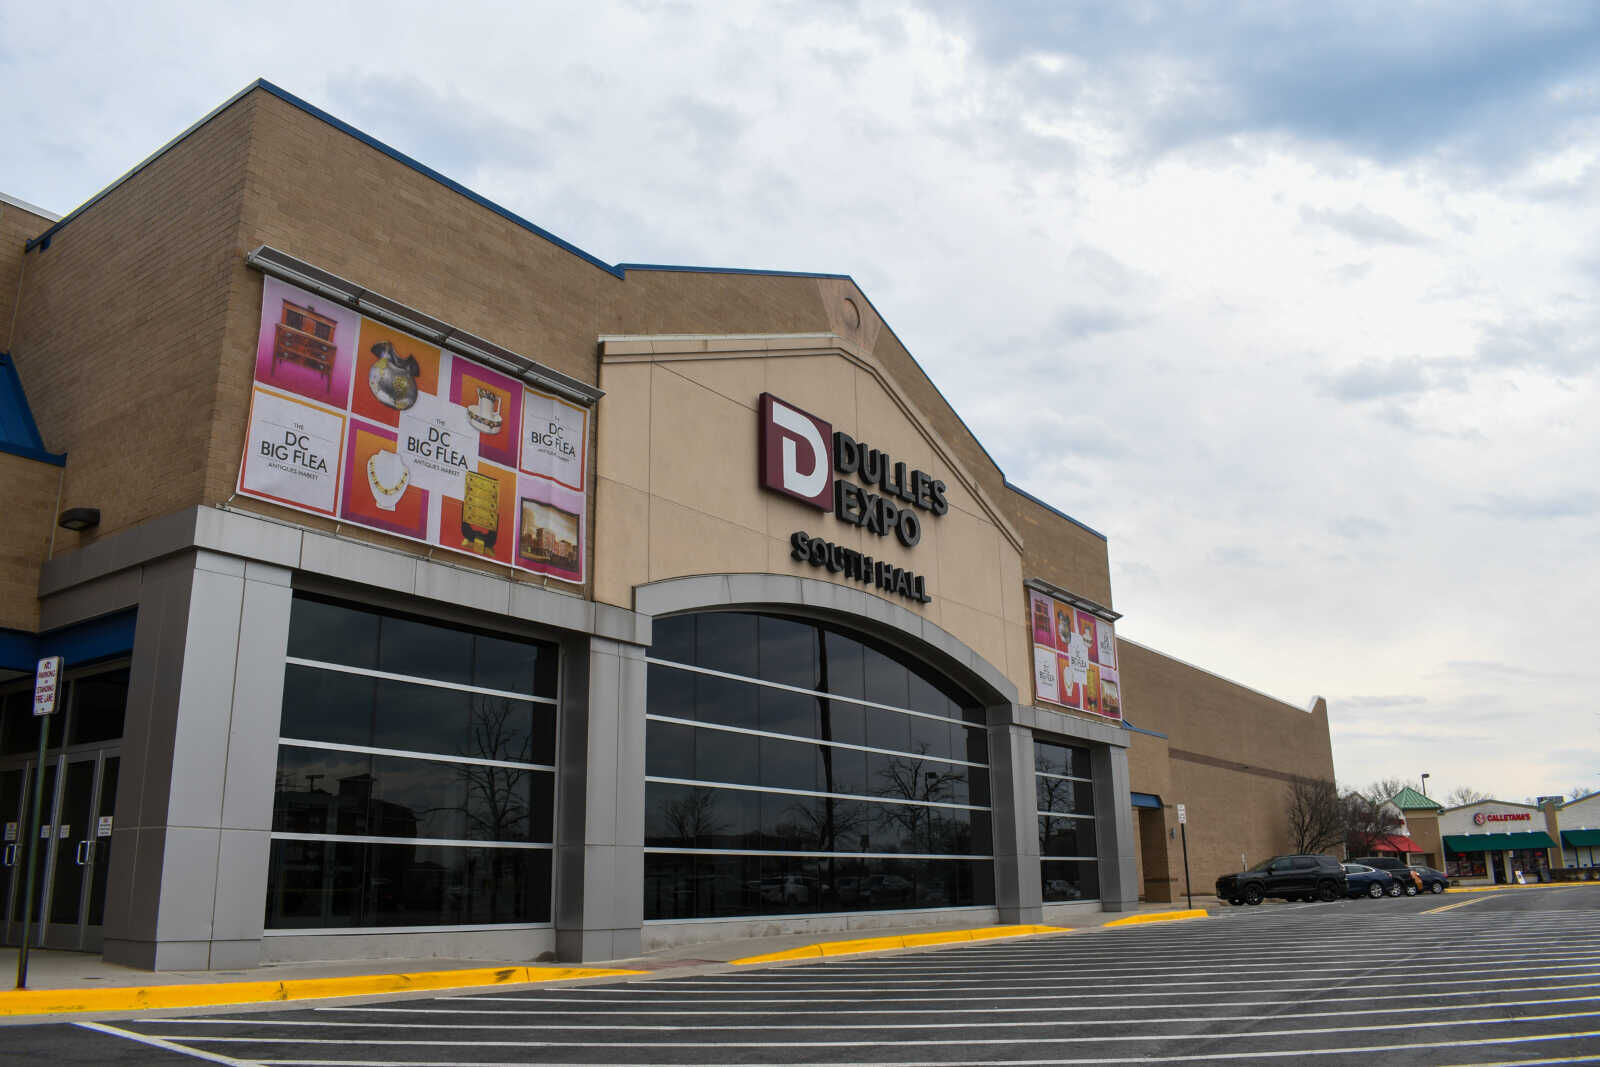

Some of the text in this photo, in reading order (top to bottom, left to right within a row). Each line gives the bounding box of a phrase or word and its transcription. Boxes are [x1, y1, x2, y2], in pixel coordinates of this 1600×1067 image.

[285, 431, 310, 451] DC
[428, 427, 451, 447] DC
[531, 431, 553, 447] BIG
[555, 438, 577, 457] FLEA
[549, 422, 564, 439] DC
[261, 440, 328, 473] BIG FLEA
[407, 436, 468, 470] BIG FLEA
[833, 431, 948, 516] DULLES
[834, 479, 921, 547] EXPO
[791, 531, 932, 603] SOUTH HALL
